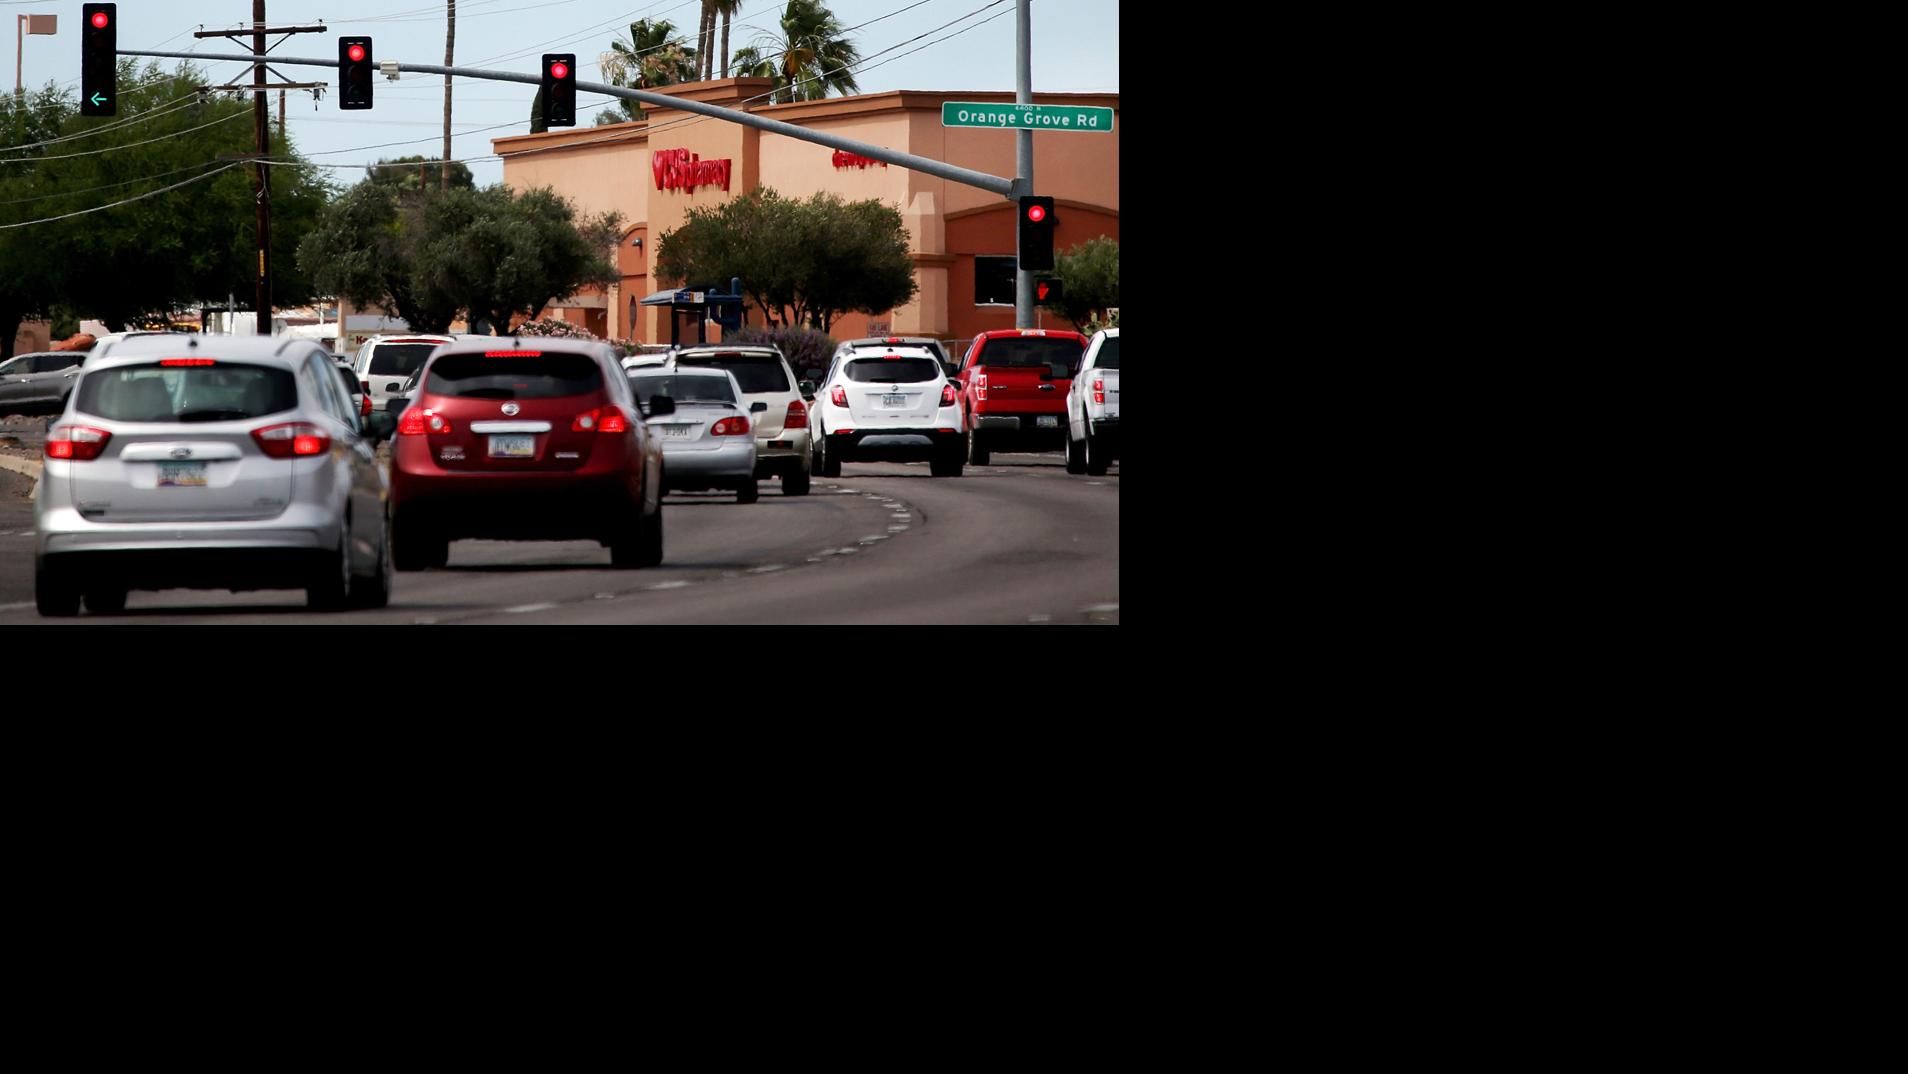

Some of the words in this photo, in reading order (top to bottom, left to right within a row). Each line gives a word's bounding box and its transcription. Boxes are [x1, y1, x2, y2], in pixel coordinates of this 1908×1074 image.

[958, 110, 1017, 127] Orange
[1023, 112, 1071, 126] Grove
[1077, 114, 1098, 127] Rd
